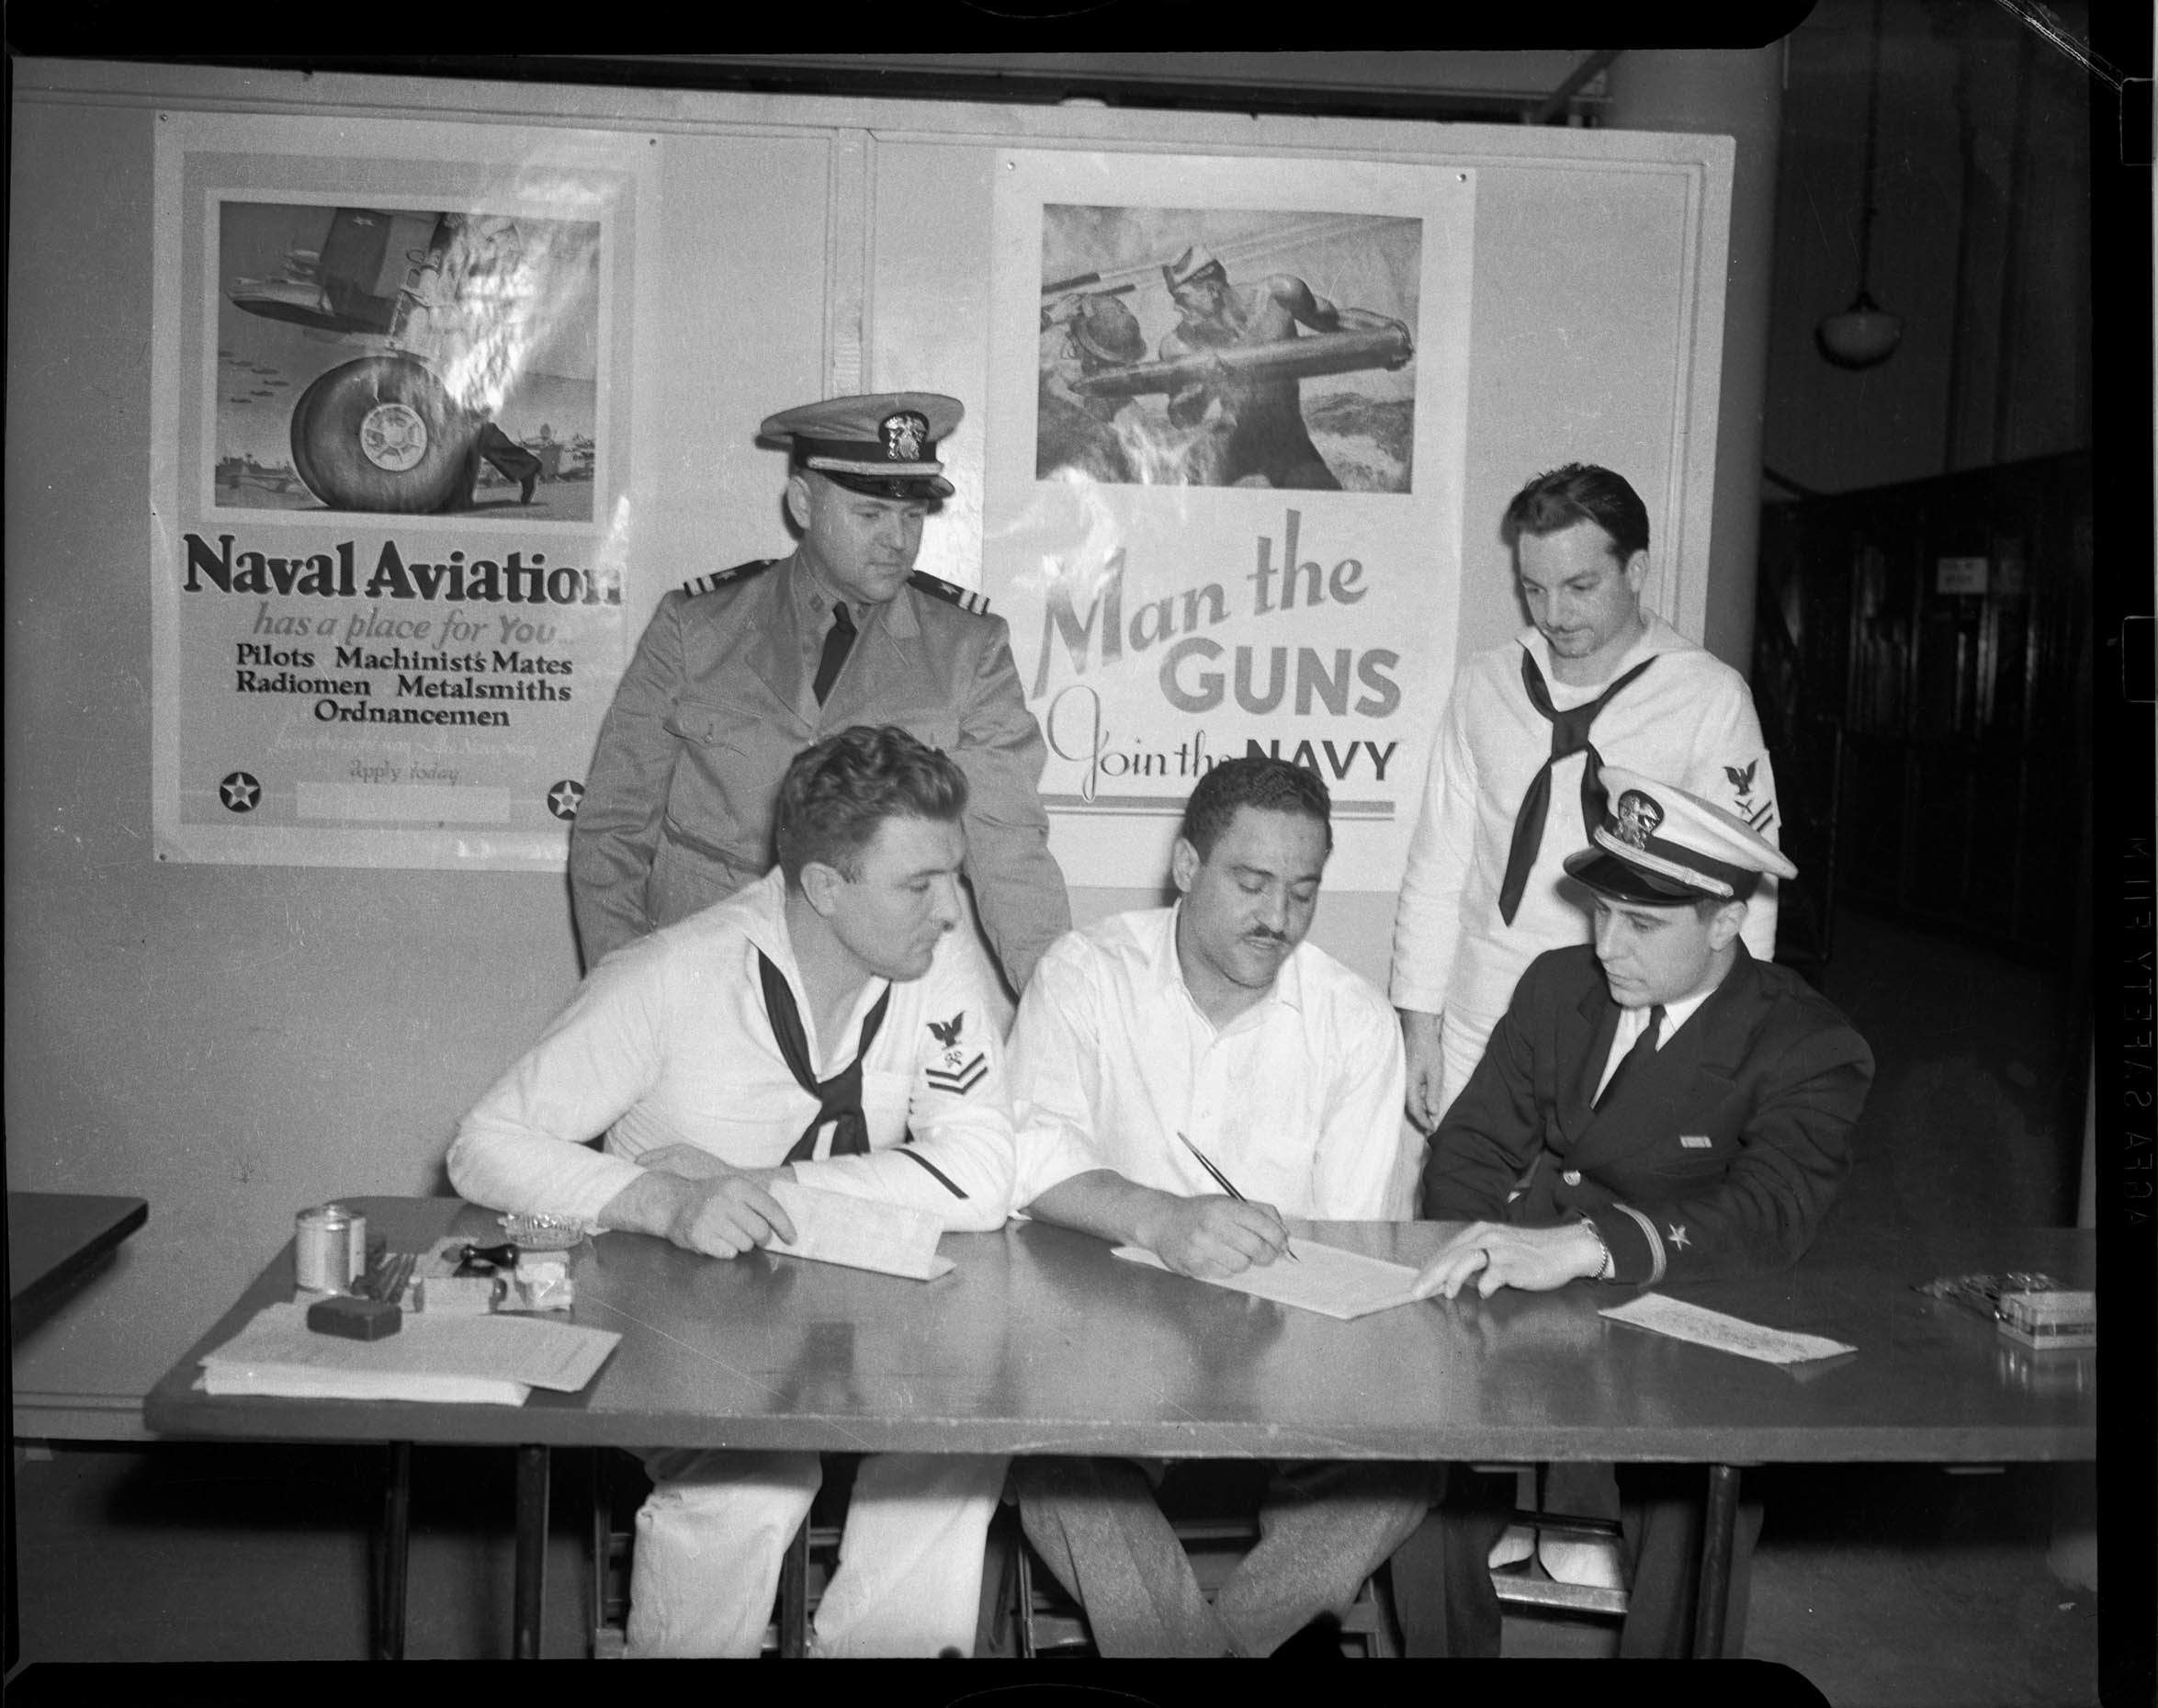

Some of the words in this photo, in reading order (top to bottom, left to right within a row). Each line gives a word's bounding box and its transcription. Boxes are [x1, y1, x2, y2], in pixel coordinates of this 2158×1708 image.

[183, 533, 356, 596] Naval
[364, 539, 623, 605] Aviation
[253, 600, 312, 637] has
[316, 616, 339, 637] a
[345, 606, 431, 647] place
[432, 608, 489, 651] for
[1032, 546, 1231, 701] Man
[1247, 507, 1370, 616] the
[235, 670, 372, 696] Radiomen
[396, 674, 572, 702] Metalsmiths
[236, 643, 316, 668] Pilots
[334, 646, 488, 673] Machinist's
[491, 650, 574, 676] Mates
[1158, 636, 1402, 719] GUNS
[313, 698, 511, 728] Ordnancemen
[1046, 684, 1168, 803] Join
